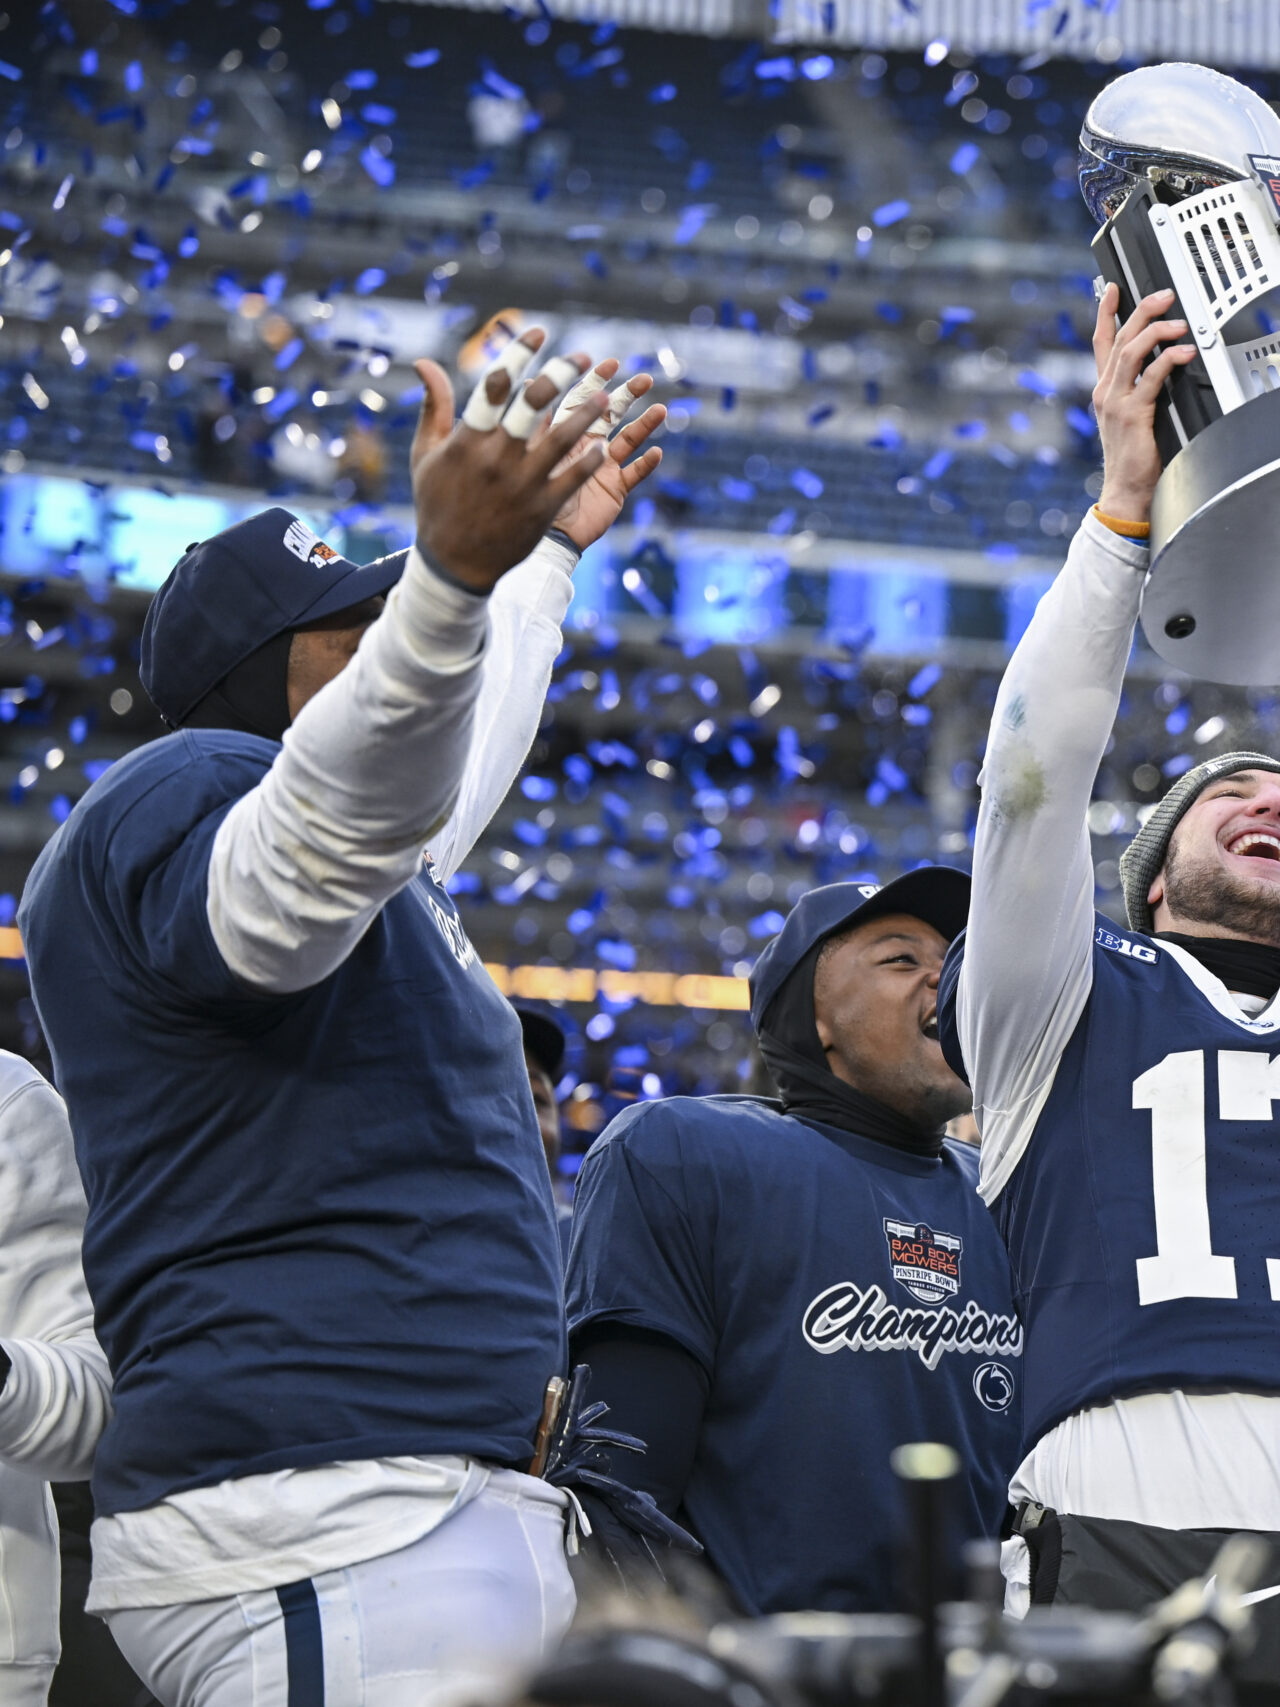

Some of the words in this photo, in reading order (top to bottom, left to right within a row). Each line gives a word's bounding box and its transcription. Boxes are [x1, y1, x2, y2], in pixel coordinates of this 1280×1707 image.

[892, 1239, 923, 1255] BAD
[928, 1247, 956, 1263] BOY
[892, 1250, 958, 1275] MOWERS
[895, 1267, 933, 1282] PINSTRIPE
[935, 1274, 956, 1291] BOWL
[802, 1281, 1024, 1371] Champions
